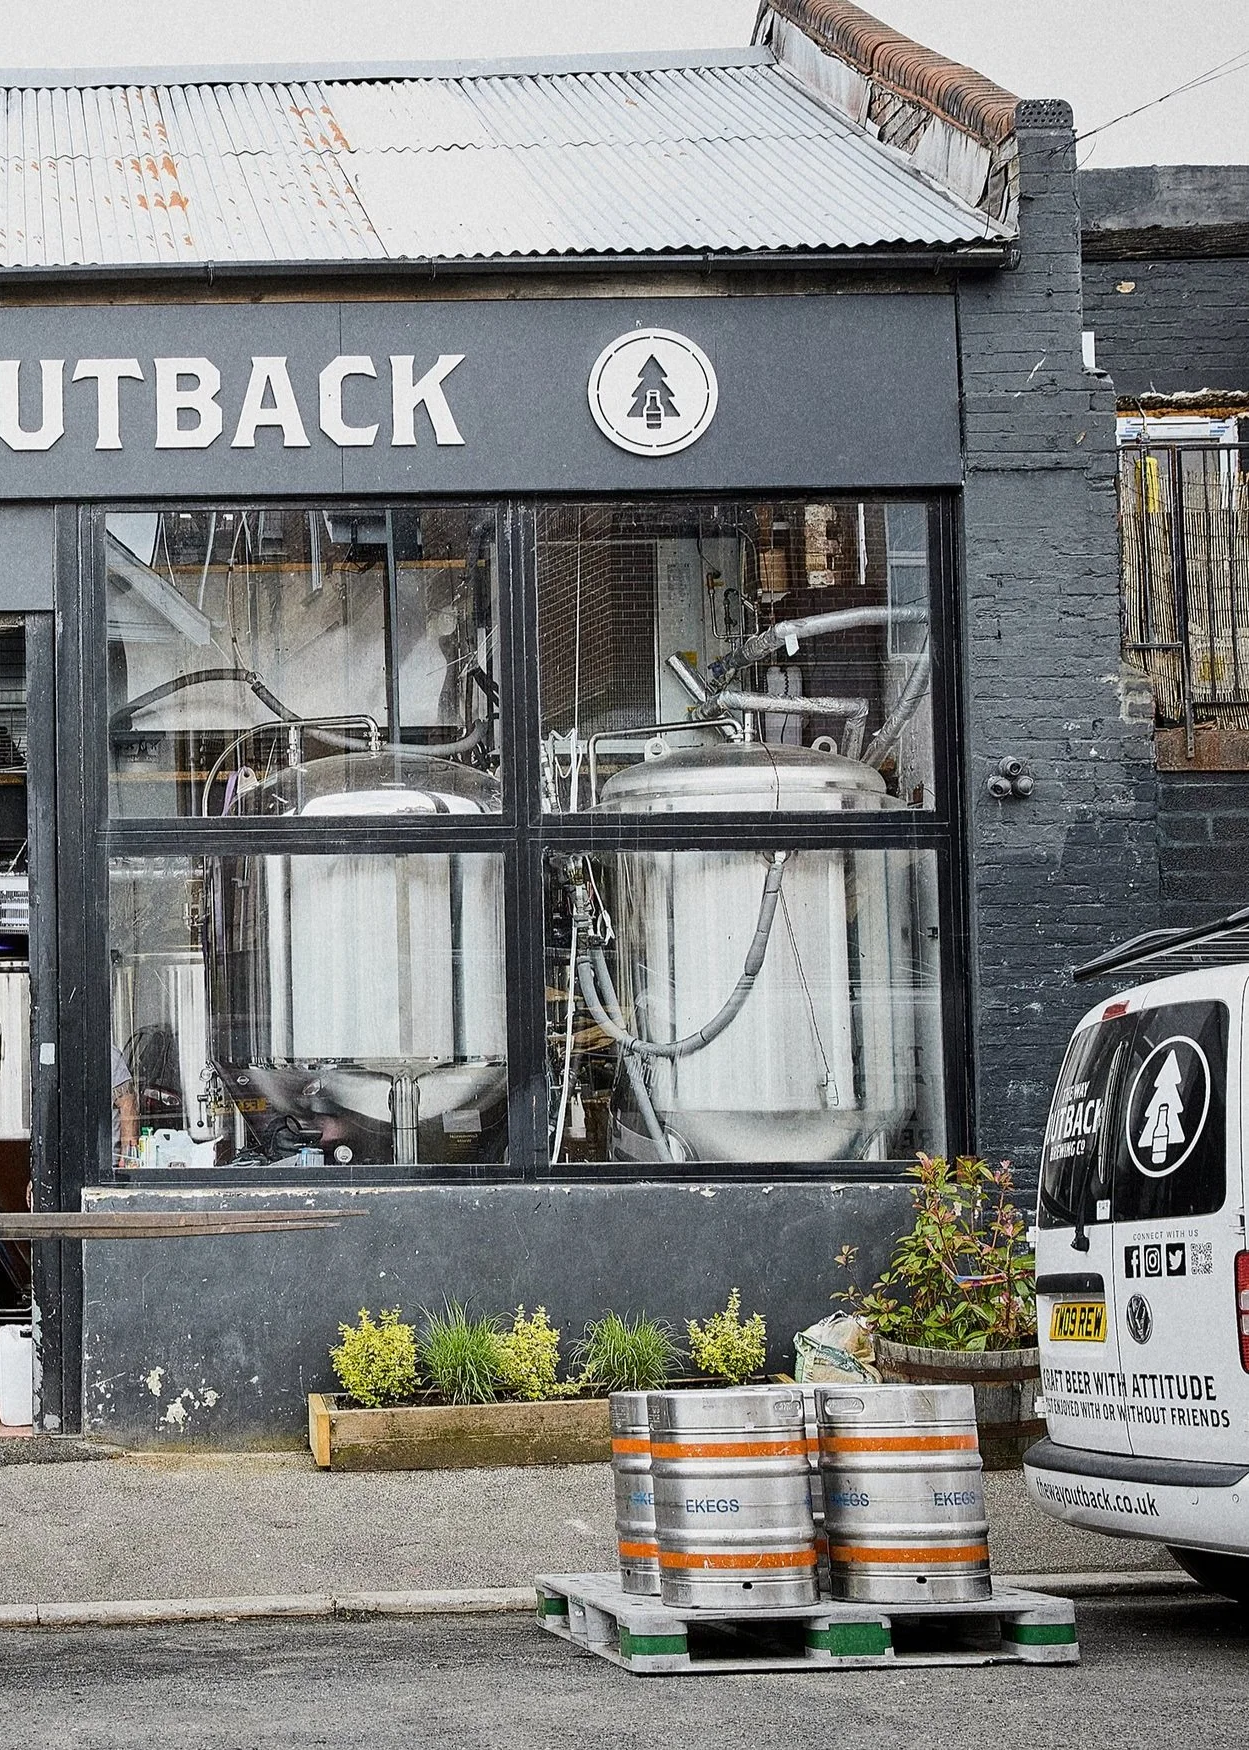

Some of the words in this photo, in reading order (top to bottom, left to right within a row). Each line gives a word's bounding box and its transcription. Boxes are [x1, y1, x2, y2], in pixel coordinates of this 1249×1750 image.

[1073, 1080, 1091, 1100] WAY
[1132, 1231, 1163, 1241] CONNECT
[1166, 1229, 1185, 1238] WITH
[1188, 1228, 1199, 1238] US
[1078, 1306, 1104, 1338] REW
[1043, 1367, 1064, 1392] CRAFT
[1065, 1369, 1092, 1395] BEER
[1092, 1371, 1127, 1398] WITH
[1132, 1373, 1217, 1401] ATTITUDE
[1053, 1398, 1080, 1417] ENJOYED
[1080, 1400, 1102, 1420] WITH
[1102, 1403, 1117, 1421] OR
[1117, 1404, 1167, 1425] WITHOUT
[1170, 1407, 1230, 1429] FRIENDS
[685, 1498, 740, 1513] EKEGS
[934, 1490, 976, 1507] EKEGS
[1036, 1476, 1160, 1517] thewayoutback.co.uk
